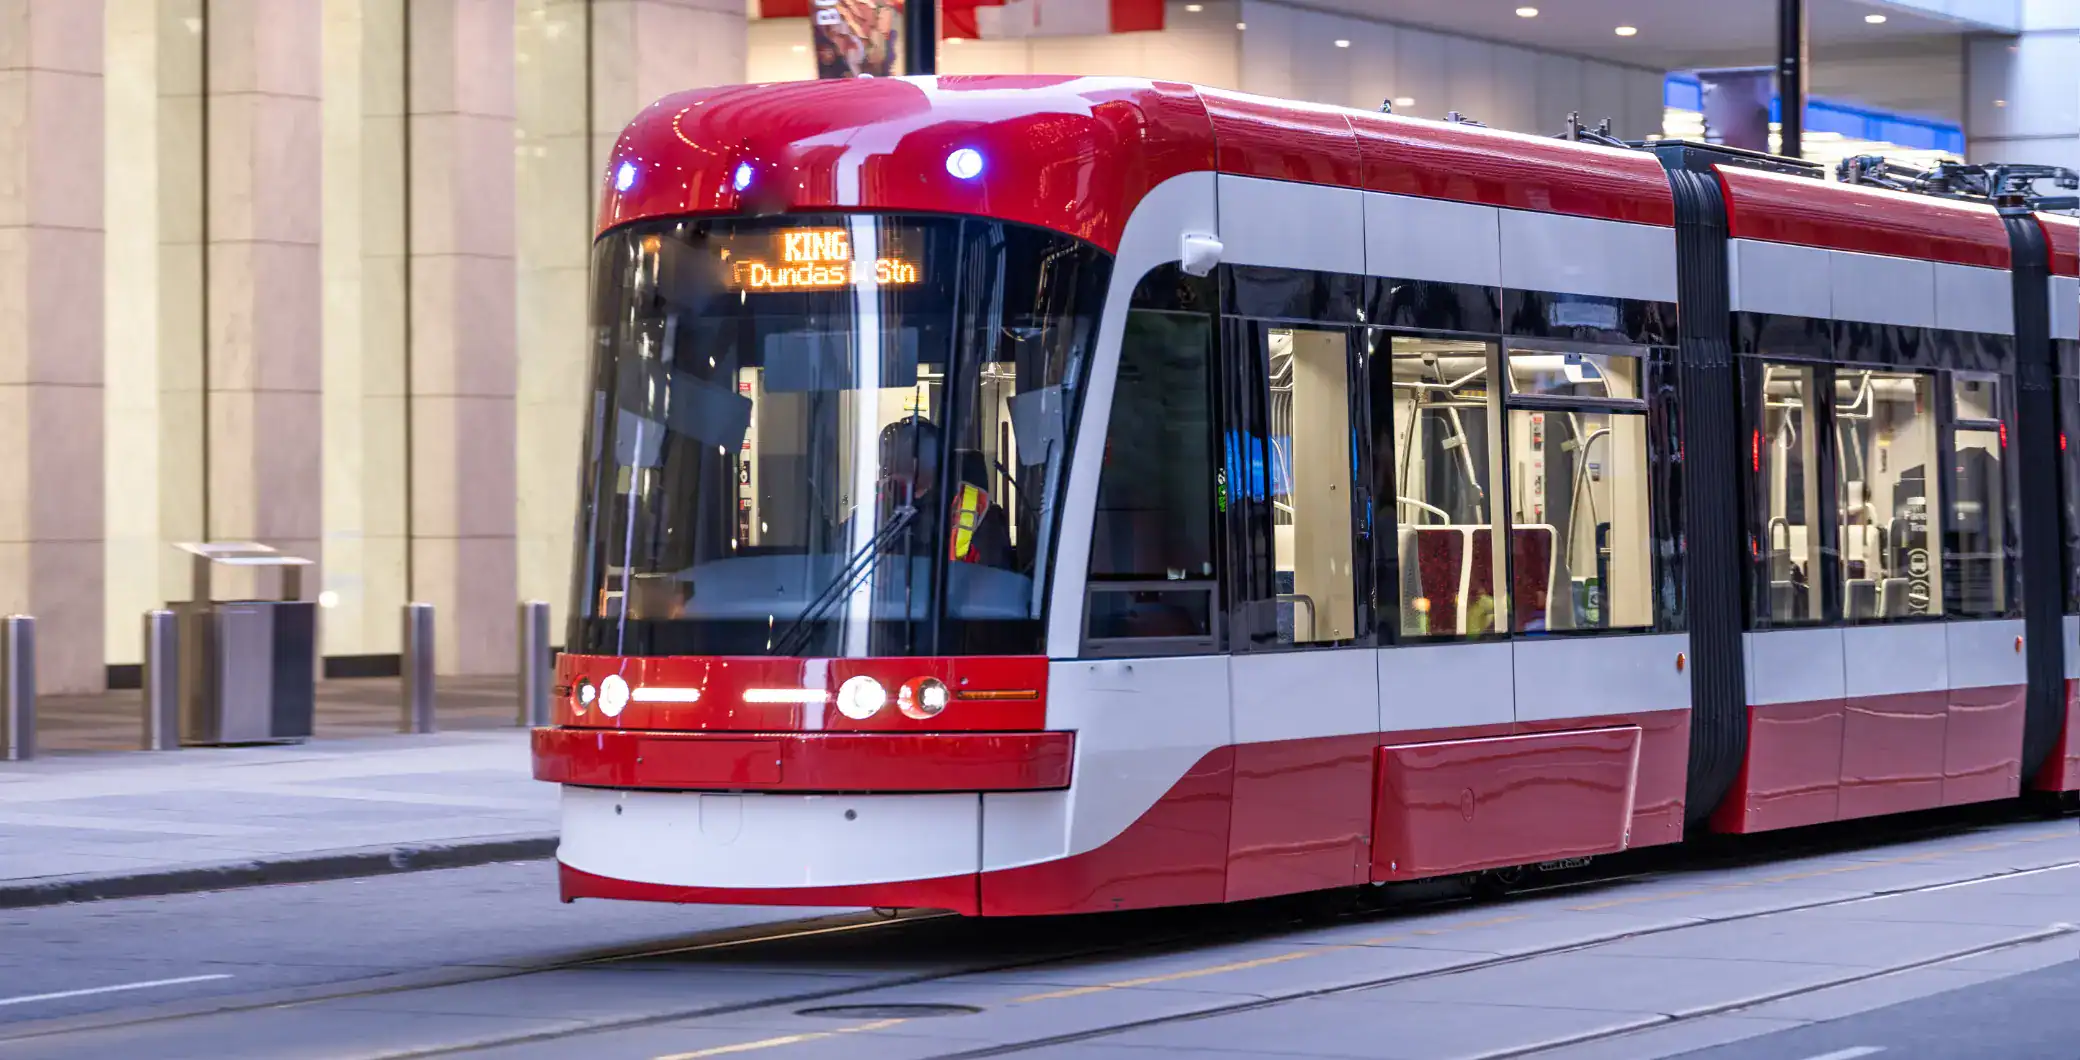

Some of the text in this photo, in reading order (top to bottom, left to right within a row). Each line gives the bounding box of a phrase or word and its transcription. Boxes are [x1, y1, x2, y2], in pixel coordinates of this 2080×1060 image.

[784, 231, 848, 261] KING
[750, 261, 846, 287] Dundas
[874, 259, 915, 284] Stn
